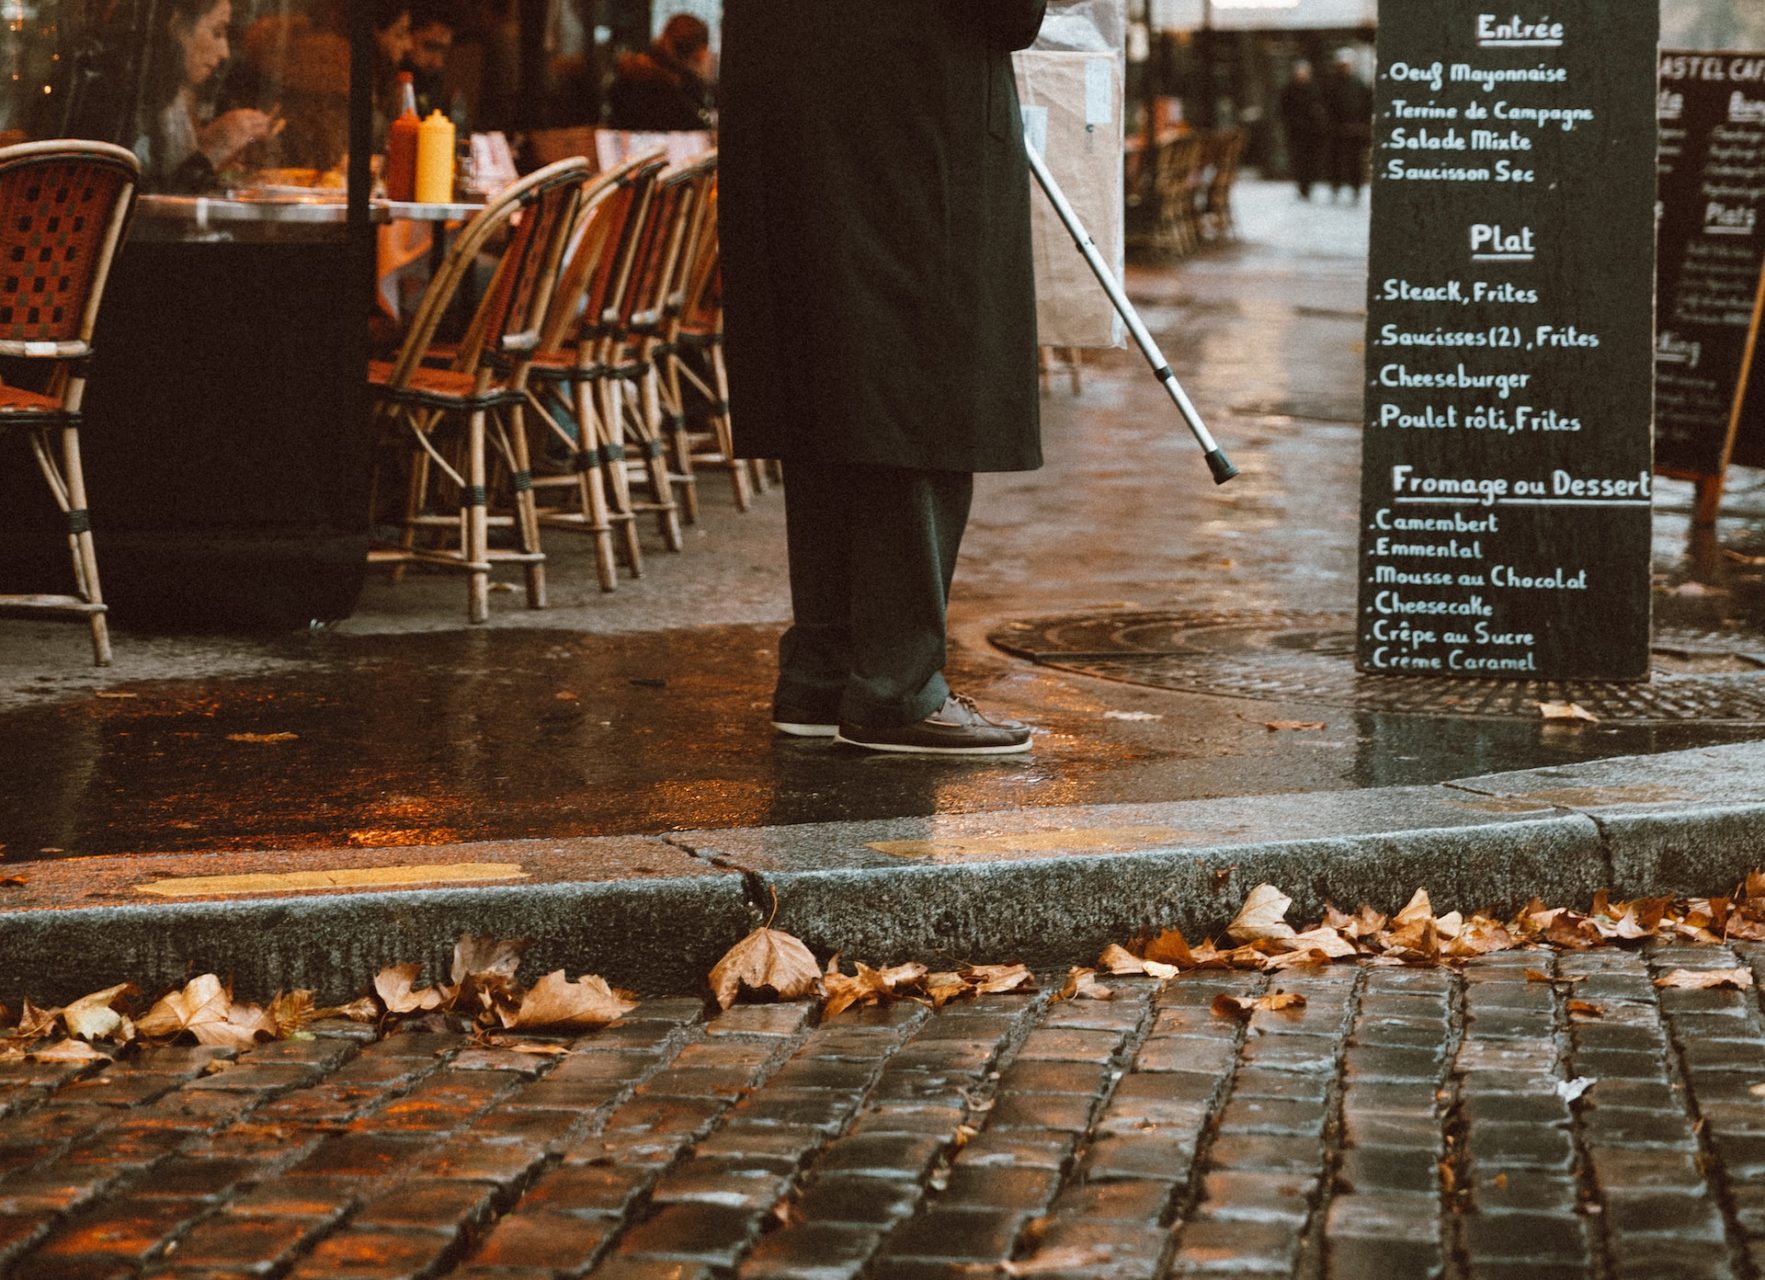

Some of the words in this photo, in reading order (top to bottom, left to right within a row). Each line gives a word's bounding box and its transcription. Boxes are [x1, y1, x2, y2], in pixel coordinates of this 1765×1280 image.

[1477, 14, 1564, 39] Entrée
[1450, 63, 1567, 92] Mayonnaise
[1660, 55, 1725, 80] ASTEL
[1391, 99, 1458, 120] Terrine
[1464, 100, 1489, 120] de
[1493, 100, 1594, 131] Campagne
[1390, 128, 1467, 151] Salade
[1471, 129, 1533, 151] Mixte
[1388, 159, 1490, 182] Saucisson
[1495, 159, 1535, 183] Sec
[1470, 223, 1536, 252] Plat
[1474, 282, 1539, 304] Frites
[1536, 325, 1600, 348] Frites
[1379, 363, 1531, 399] Cheeseburger
[1380, 404, 1458, 429] Poulet
[1393, 465, 1508, 506] Fromage
[1513, 480, 1546, 496] ou
[1553, 470, 1651, 497] Dessert
[1375, 508, 1499, 533] Camembert
[1376, 537, 1484, 559] Emmental
[1375, 565, 1453, 586] Mousse
[1457, 574, 1486, 587] au
[1490, 564, 1588, 590] Chocolat
[1373, 619, 1437, 649] Crêpe
[1442, 632, 1470, 644] au
[1474, 621, 1535, 645] Sucre
[1448, 649, 1537, 671] Caramel
